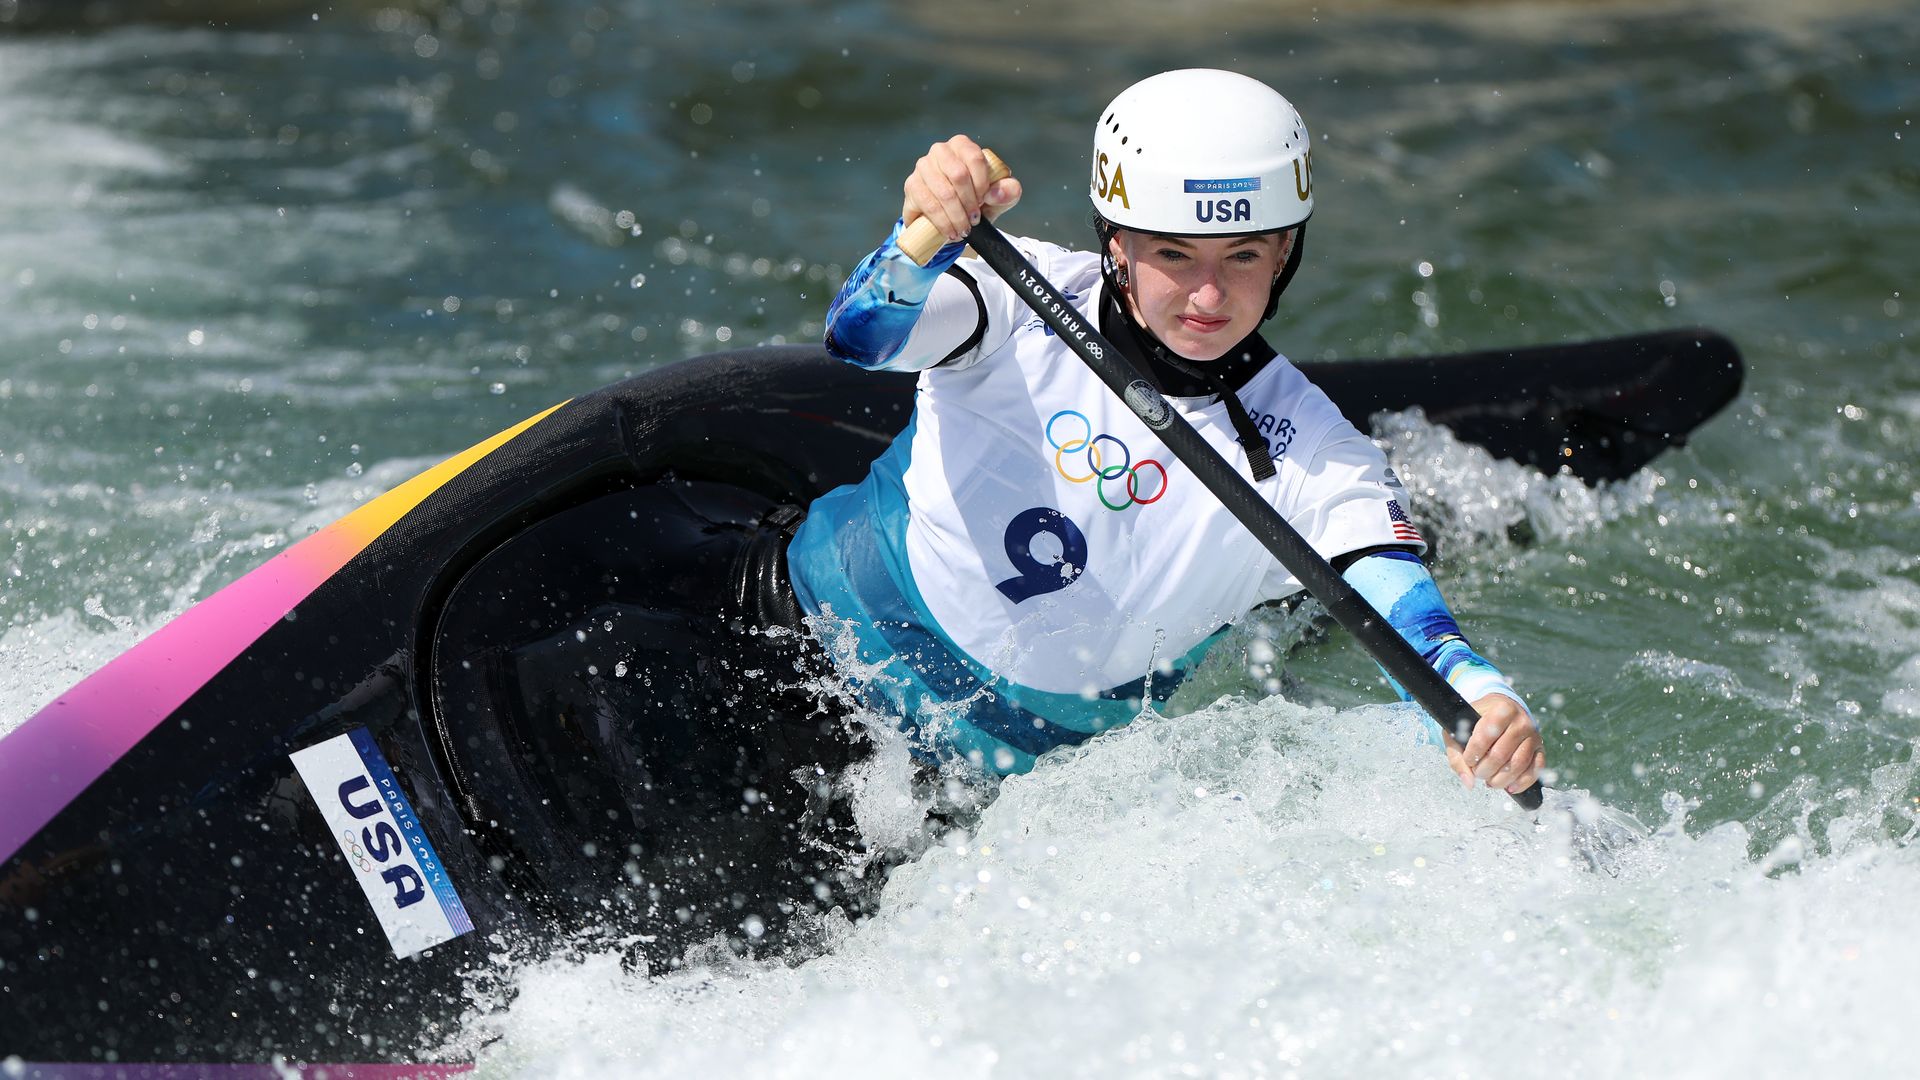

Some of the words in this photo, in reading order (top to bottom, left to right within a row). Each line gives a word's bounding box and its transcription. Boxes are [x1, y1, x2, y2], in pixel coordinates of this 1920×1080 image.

[1091, 149, 1130, 210] USA
[1196, 198, 1251, 223] USA
[1019, 269, 1052, 304] 2024
[1050, 303, 1087, 340] PARIS
[995, 507, 1088, 605] 9
[338, 774, 425, 909] USA
[380, 778, 413, 830] PARIS
[411, 836, 440, 883] 2024
